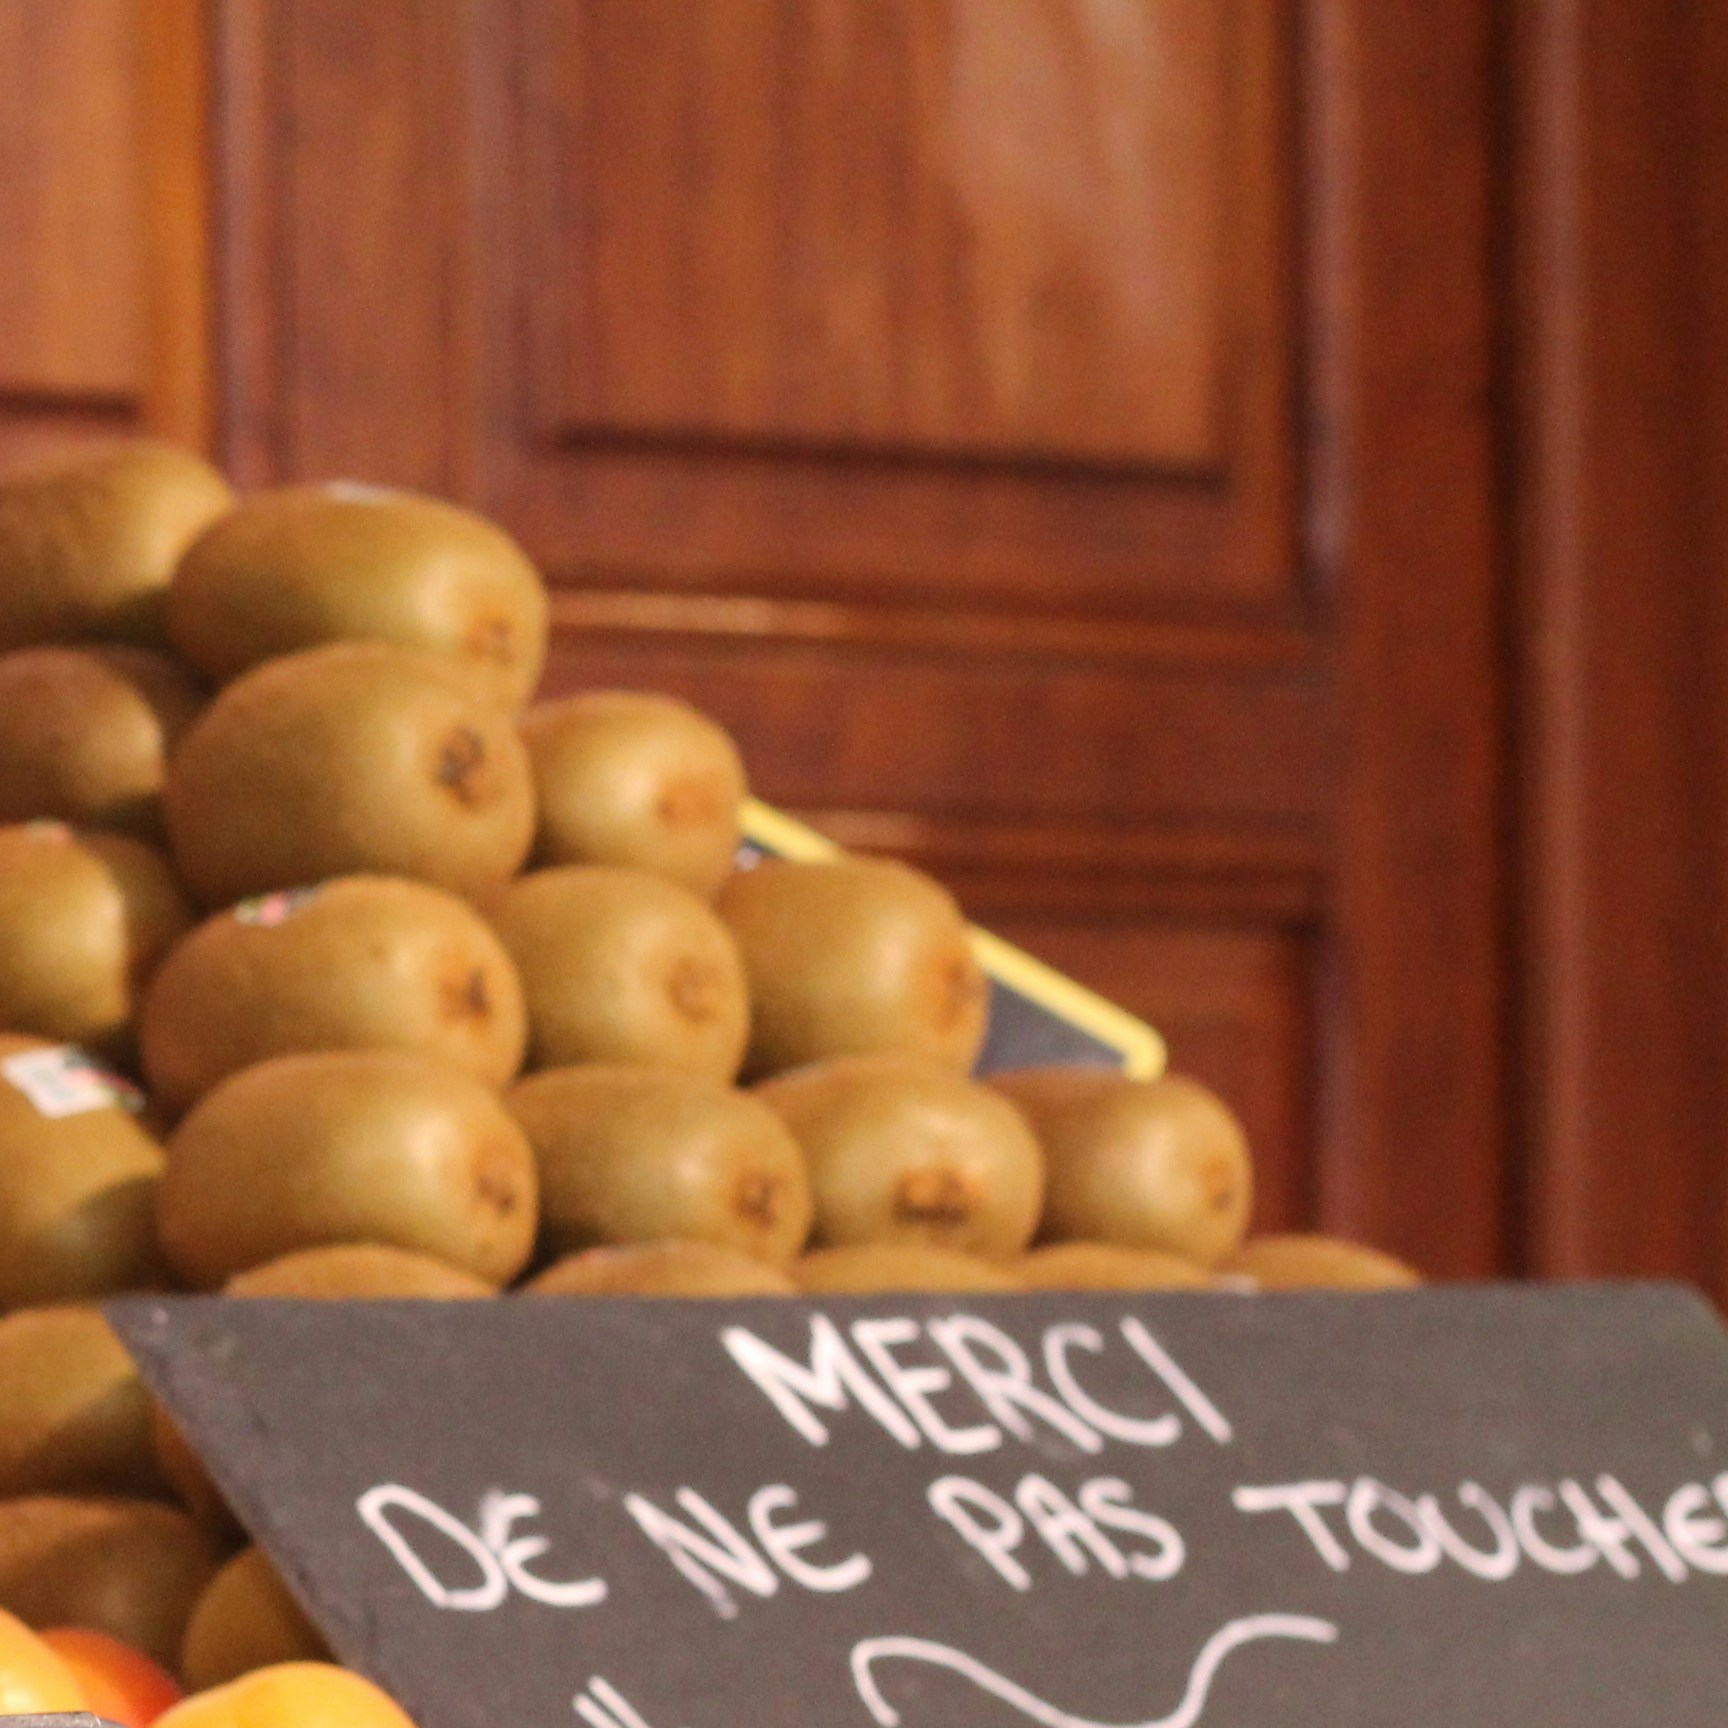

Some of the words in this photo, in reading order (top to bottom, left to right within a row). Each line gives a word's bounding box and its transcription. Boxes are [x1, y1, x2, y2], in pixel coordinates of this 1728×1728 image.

[722, 1313, 1233, 1454] MERCI
[356, 1484, 607, 1611] DE
[625, 1485, 872, 1619] NE
[928, 1474, 1184, 1591] PAS
[1234, 1476, 1728, 1584] TOUCHE
